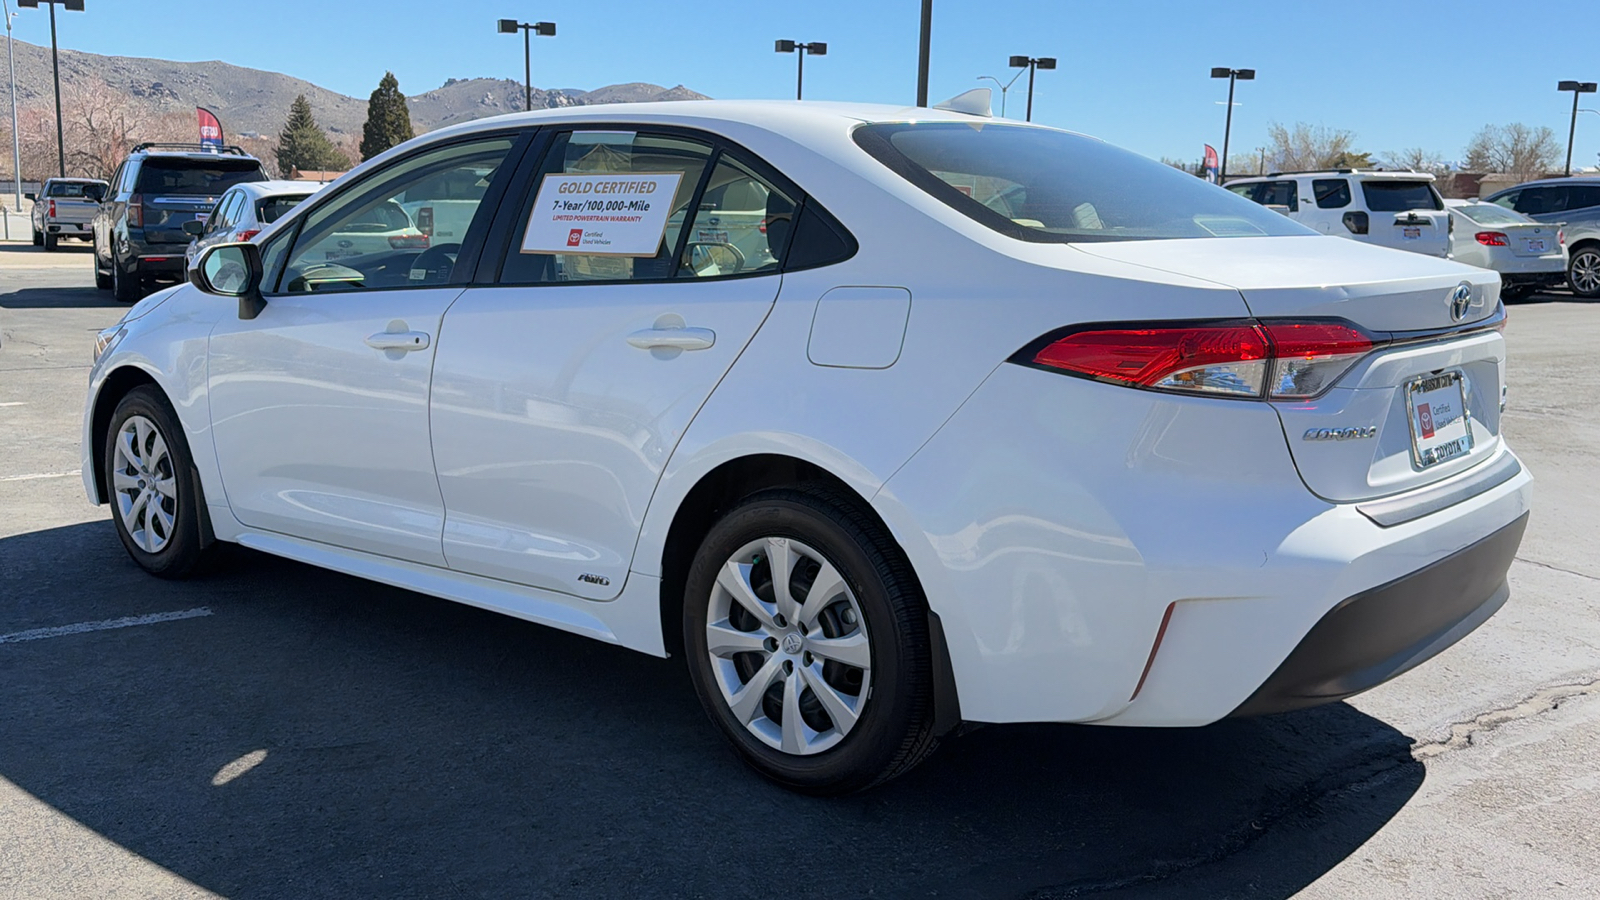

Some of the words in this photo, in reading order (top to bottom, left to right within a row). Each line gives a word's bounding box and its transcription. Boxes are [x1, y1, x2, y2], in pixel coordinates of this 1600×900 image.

[558, 182, 593, 194] GOLD
[594, 181, 657, 194] CERTIFIED
[552, 200, 651, 212] 7-Year/100,000-Mile
[1433, 403, 1450, 415] Certified
[1435, 440, 1461, 459] TOYOTA
